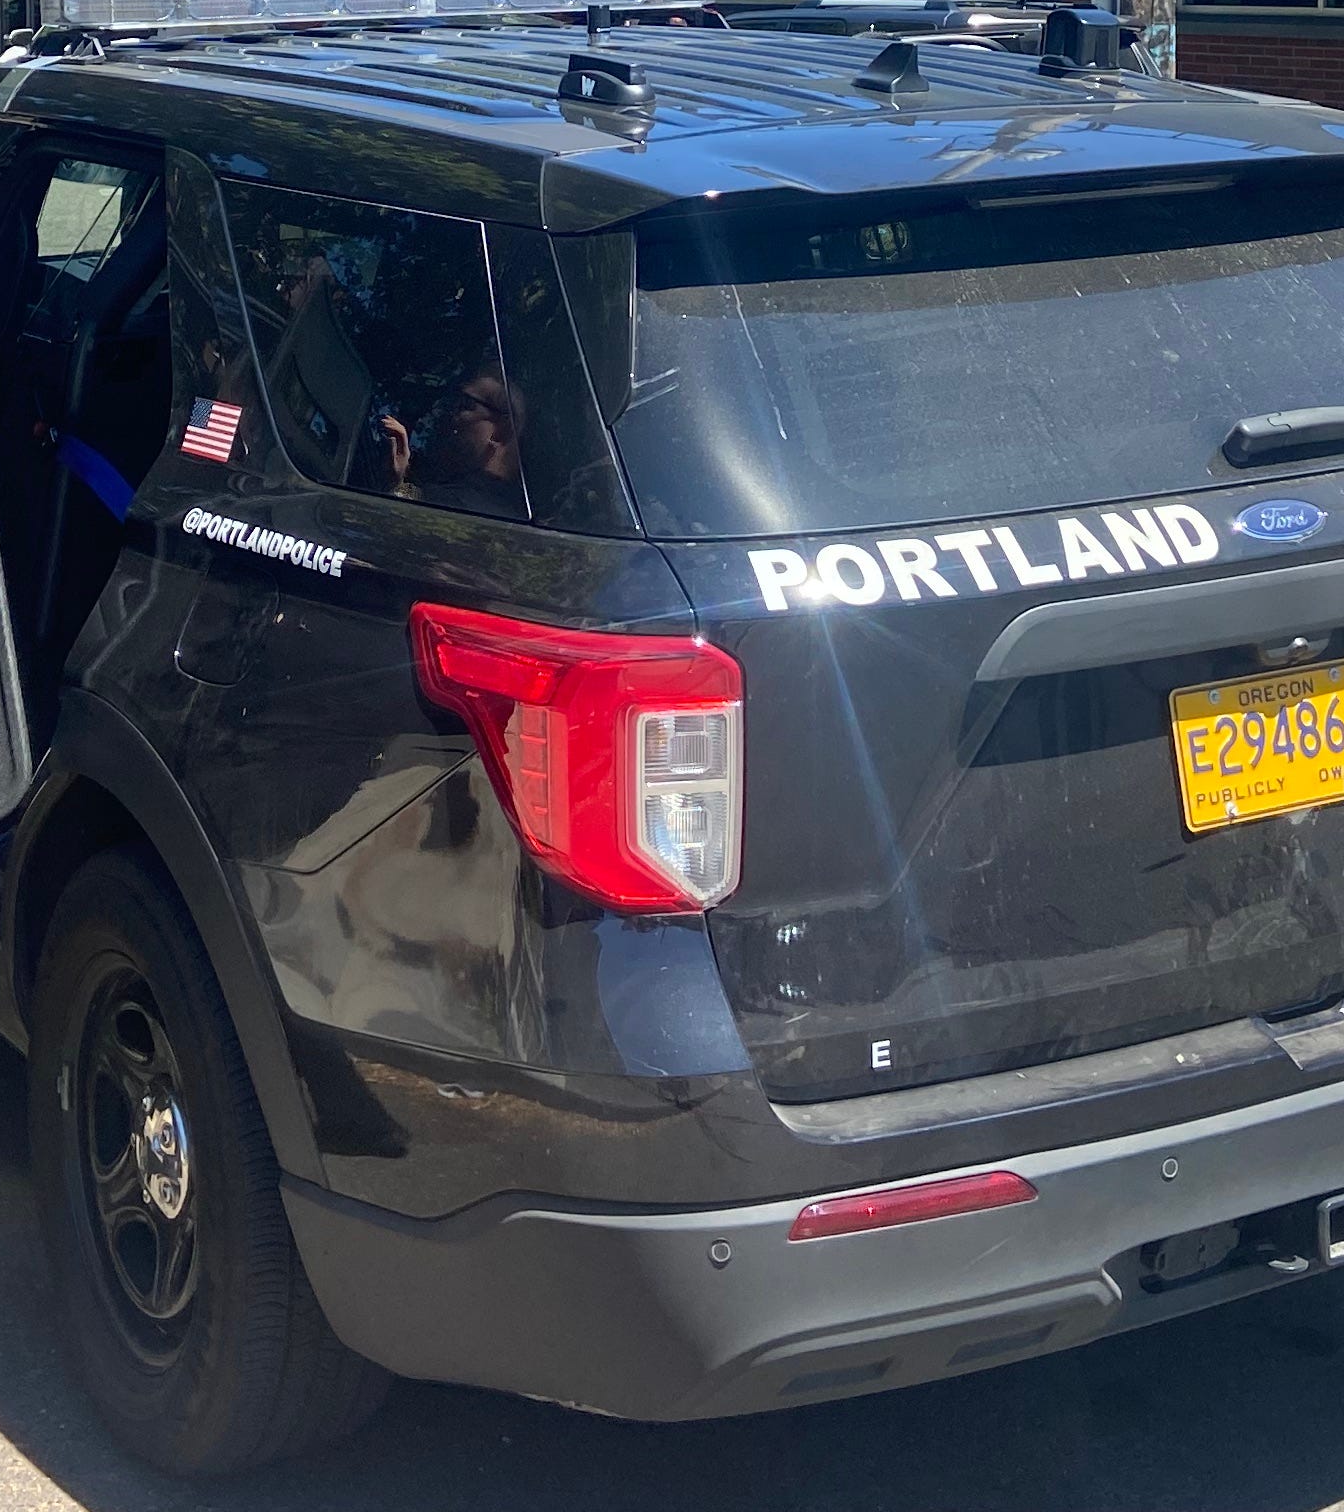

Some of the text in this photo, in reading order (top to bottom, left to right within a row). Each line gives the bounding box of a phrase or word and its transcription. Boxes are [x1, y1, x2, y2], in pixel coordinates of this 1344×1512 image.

[1260, 507, 1309, 531] Ford
[182, 507, 347, 578] @PORTLANDPOLICE
[747, 503, 1219, 612] PORTLAND
[1238, 678, 1314, 707] OREGON
[1196, 777, 1286, 807] PUBLICLY
[871, 1039, 891, 1069] E
